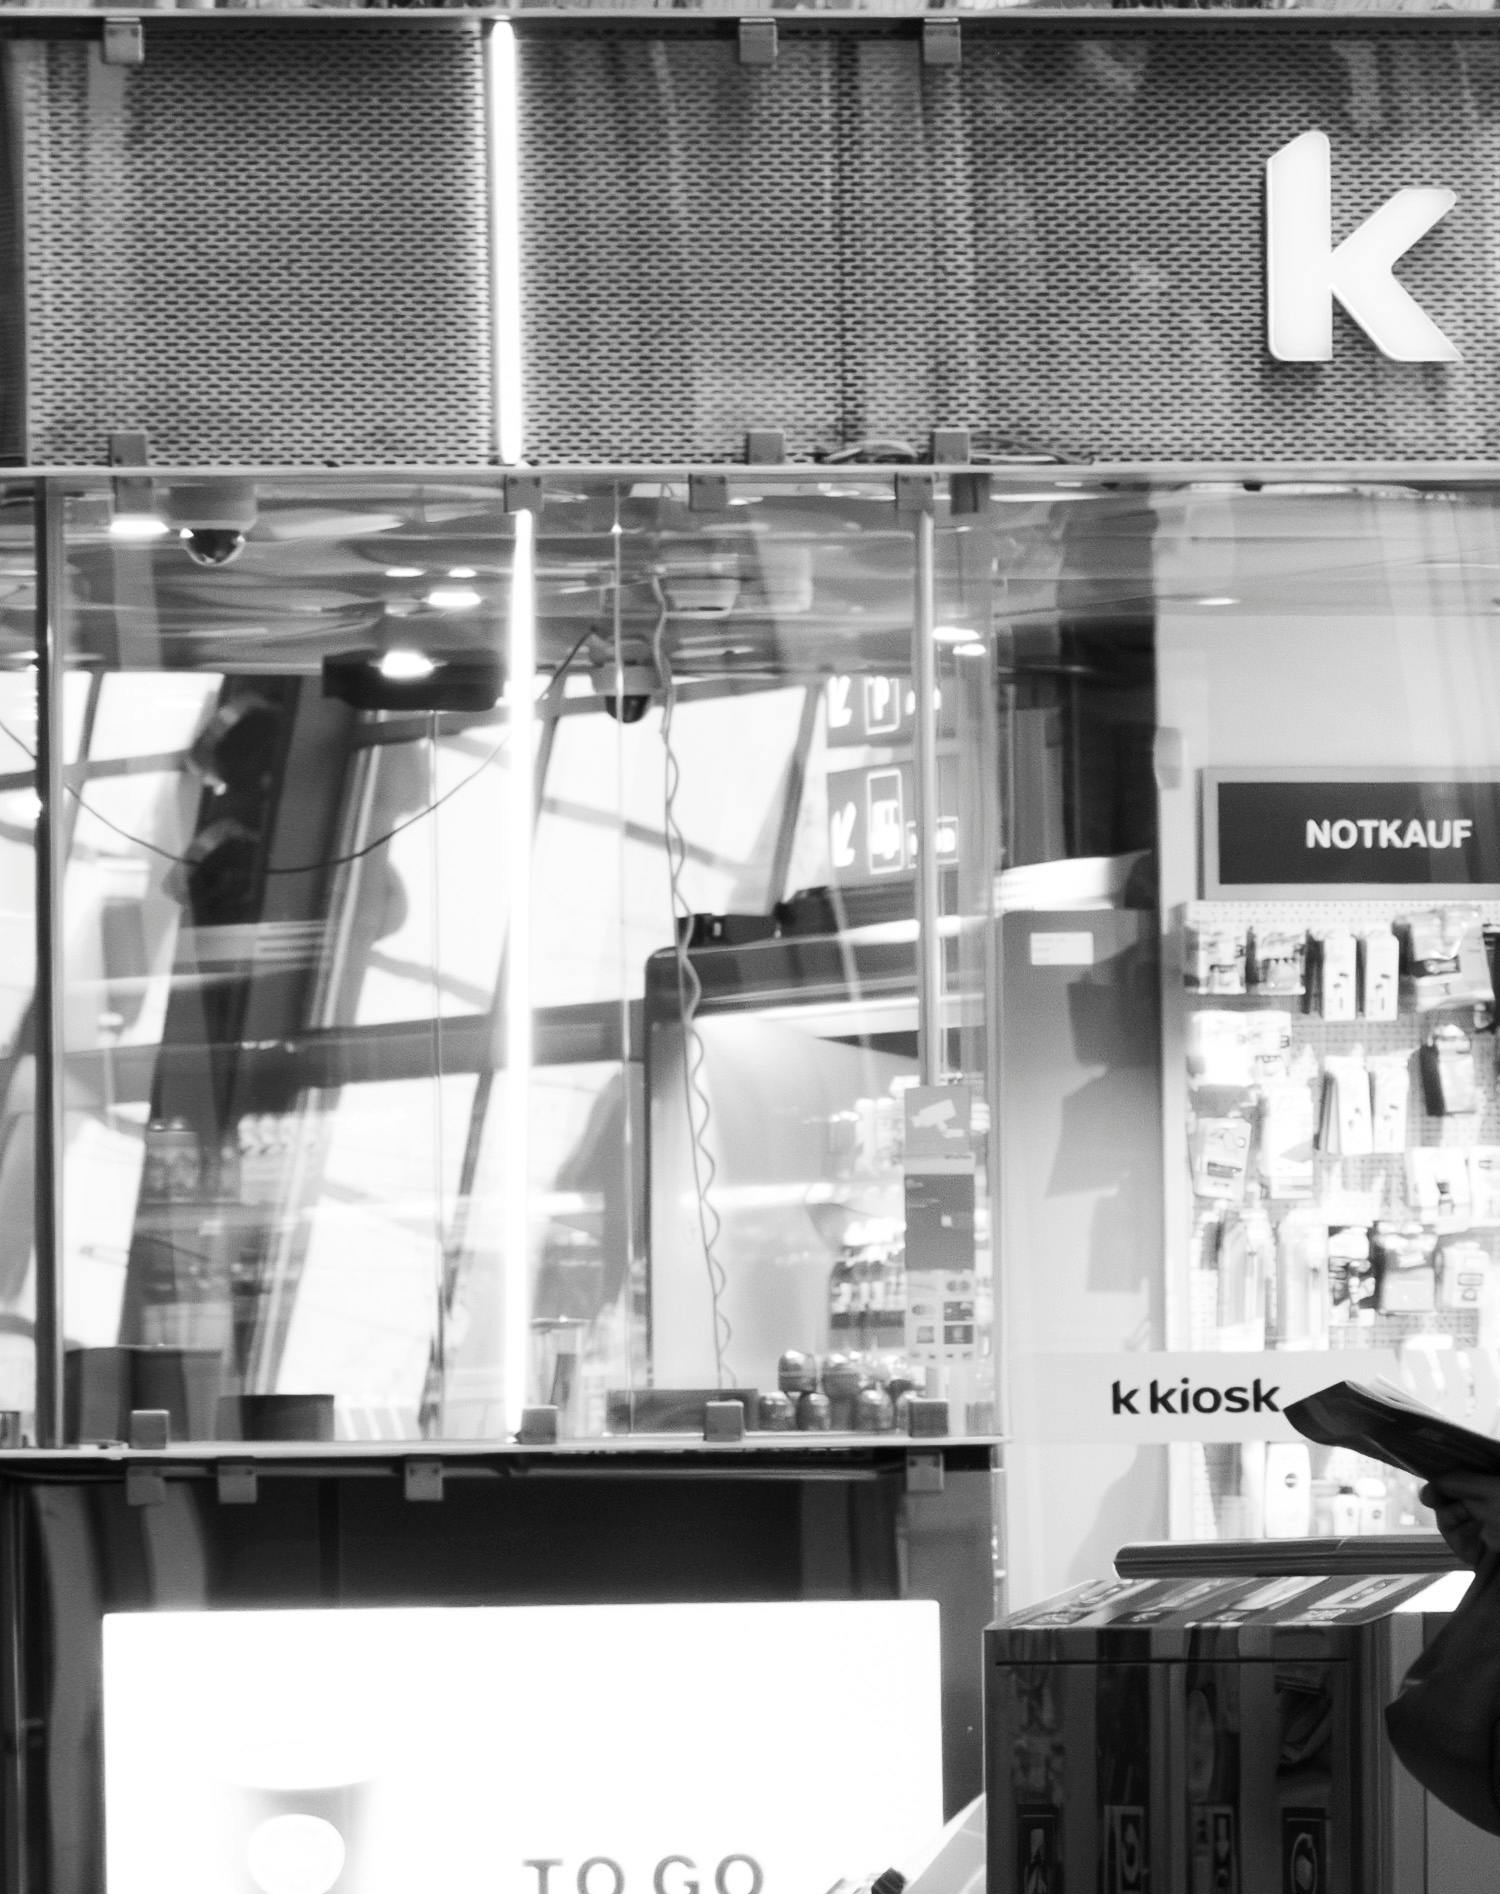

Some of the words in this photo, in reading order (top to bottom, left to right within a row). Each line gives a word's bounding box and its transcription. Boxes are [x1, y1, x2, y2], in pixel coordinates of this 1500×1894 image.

[1266, 130, 1461, 362] k
[1305, 819, 1473, 850] NOTKAUF
[1111, 1380, 1140, 1415] k
[1150, 1377, 1282, 1414] kiosk
